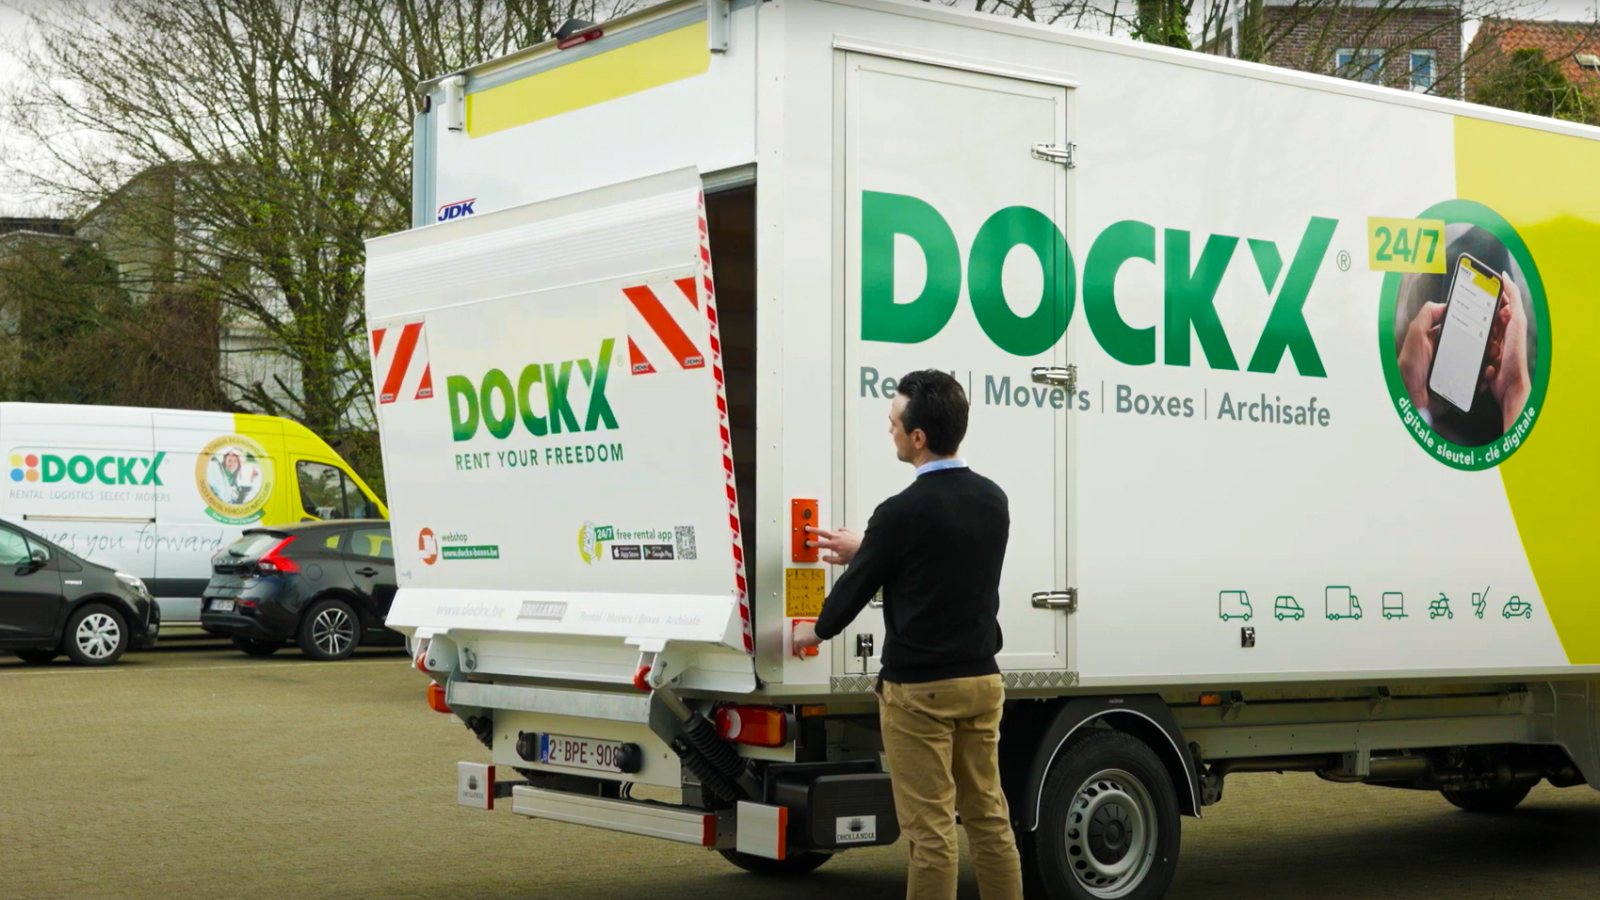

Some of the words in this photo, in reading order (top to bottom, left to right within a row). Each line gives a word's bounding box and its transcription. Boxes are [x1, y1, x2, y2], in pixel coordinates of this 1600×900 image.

[438, 200, 475, 221] JDK
[1375, 226, 1439, 264] 24/7
[861, 189, 1339, 378] DOCKX
[446, 338, 620, 442] DOCKX
[985, 374, 1091, 411] Movers
[1116, 384, 1194, 418] Boxes
[1217, 392, 1331, 427] Archisafe
[1399, 397, 1434, 448] digitale
[1436, 444, 1474, 465] sleutel
[1485, 445, 1500, 462] clé
[1502, 407, 1535, 452] digitale
[41, 451, 167, 486] DOCKX
[455, 452, 491, 470] RENT
[497, 449, 539, 468] YOUR
[545, 443, 624, 466] FREEDOM
[9, 490, 44, 499] RENTAL
[50, 490, 94, 500] LOGISTICS
[100, 491, 130, 501] SELECT
[135, 492, 171, 502] MOVERS
[87, 534, 126, 560] you
[135, 521, 225, 553] forward
[441, 532, 468, 543] webshop
[596, 527, 613, 539] 24/7
[616, 528, 632, 540] free
[633, 528, 656, 540] rental
[657, 531, 673, 542] app
